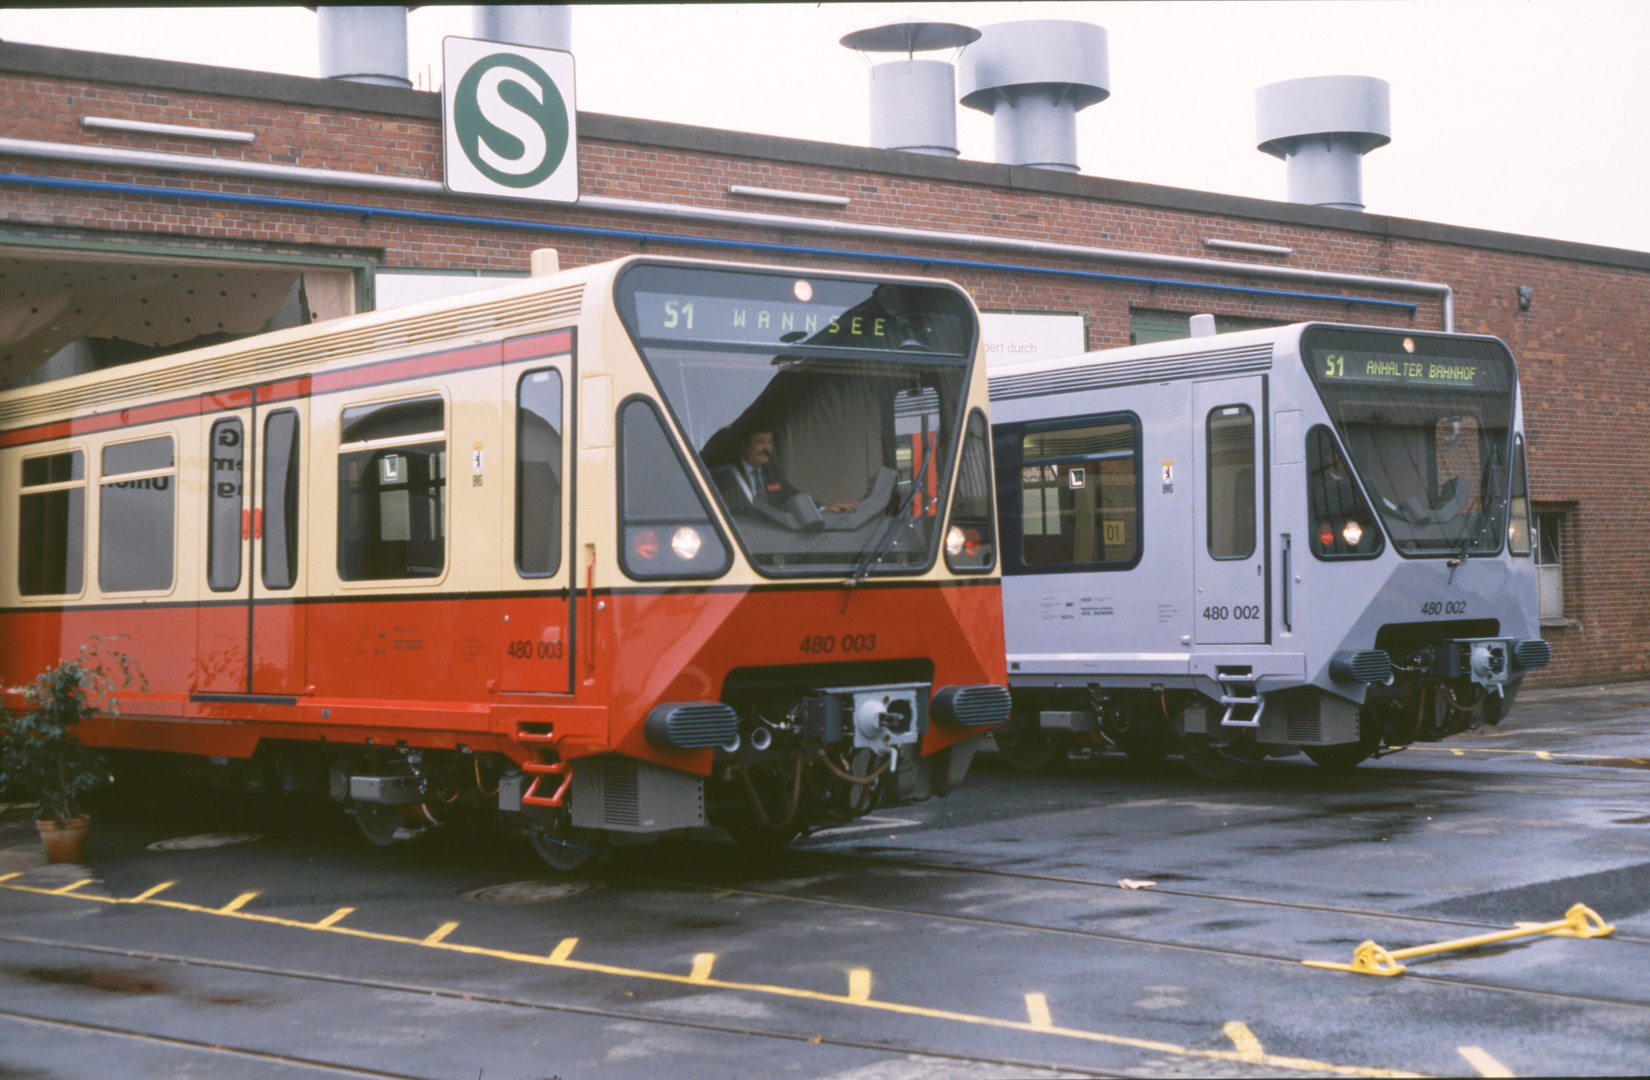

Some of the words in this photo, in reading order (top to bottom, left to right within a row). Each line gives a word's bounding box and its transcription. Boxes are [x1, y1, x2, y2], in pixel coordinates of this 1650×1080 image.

[476, 65, 547, 175] S
[663, 300, 694, 330] S1
[733, 308, 886, 337] WANNSEE
[1007, 342, 1038, 353] durch
[1325, 354, 1345, 377] S1
[1366, 360, 1424, 378] ANHALTER
[1428, 364, 1478, 381] BAHNHOF
[1106, 524, 1120, 542] 01
[1202, 605, 1229, 620] 480
[1233, 605, 1260, 620] 002
[1421, 602, 1443, 616] 480
[1445, 600, 1467, 615] 002
[507, 640, 533, 659] 480
[537, 640, 564, 659] 003
[799, 634, 836, 654] 480
[841, 632, 877, 653] 003
